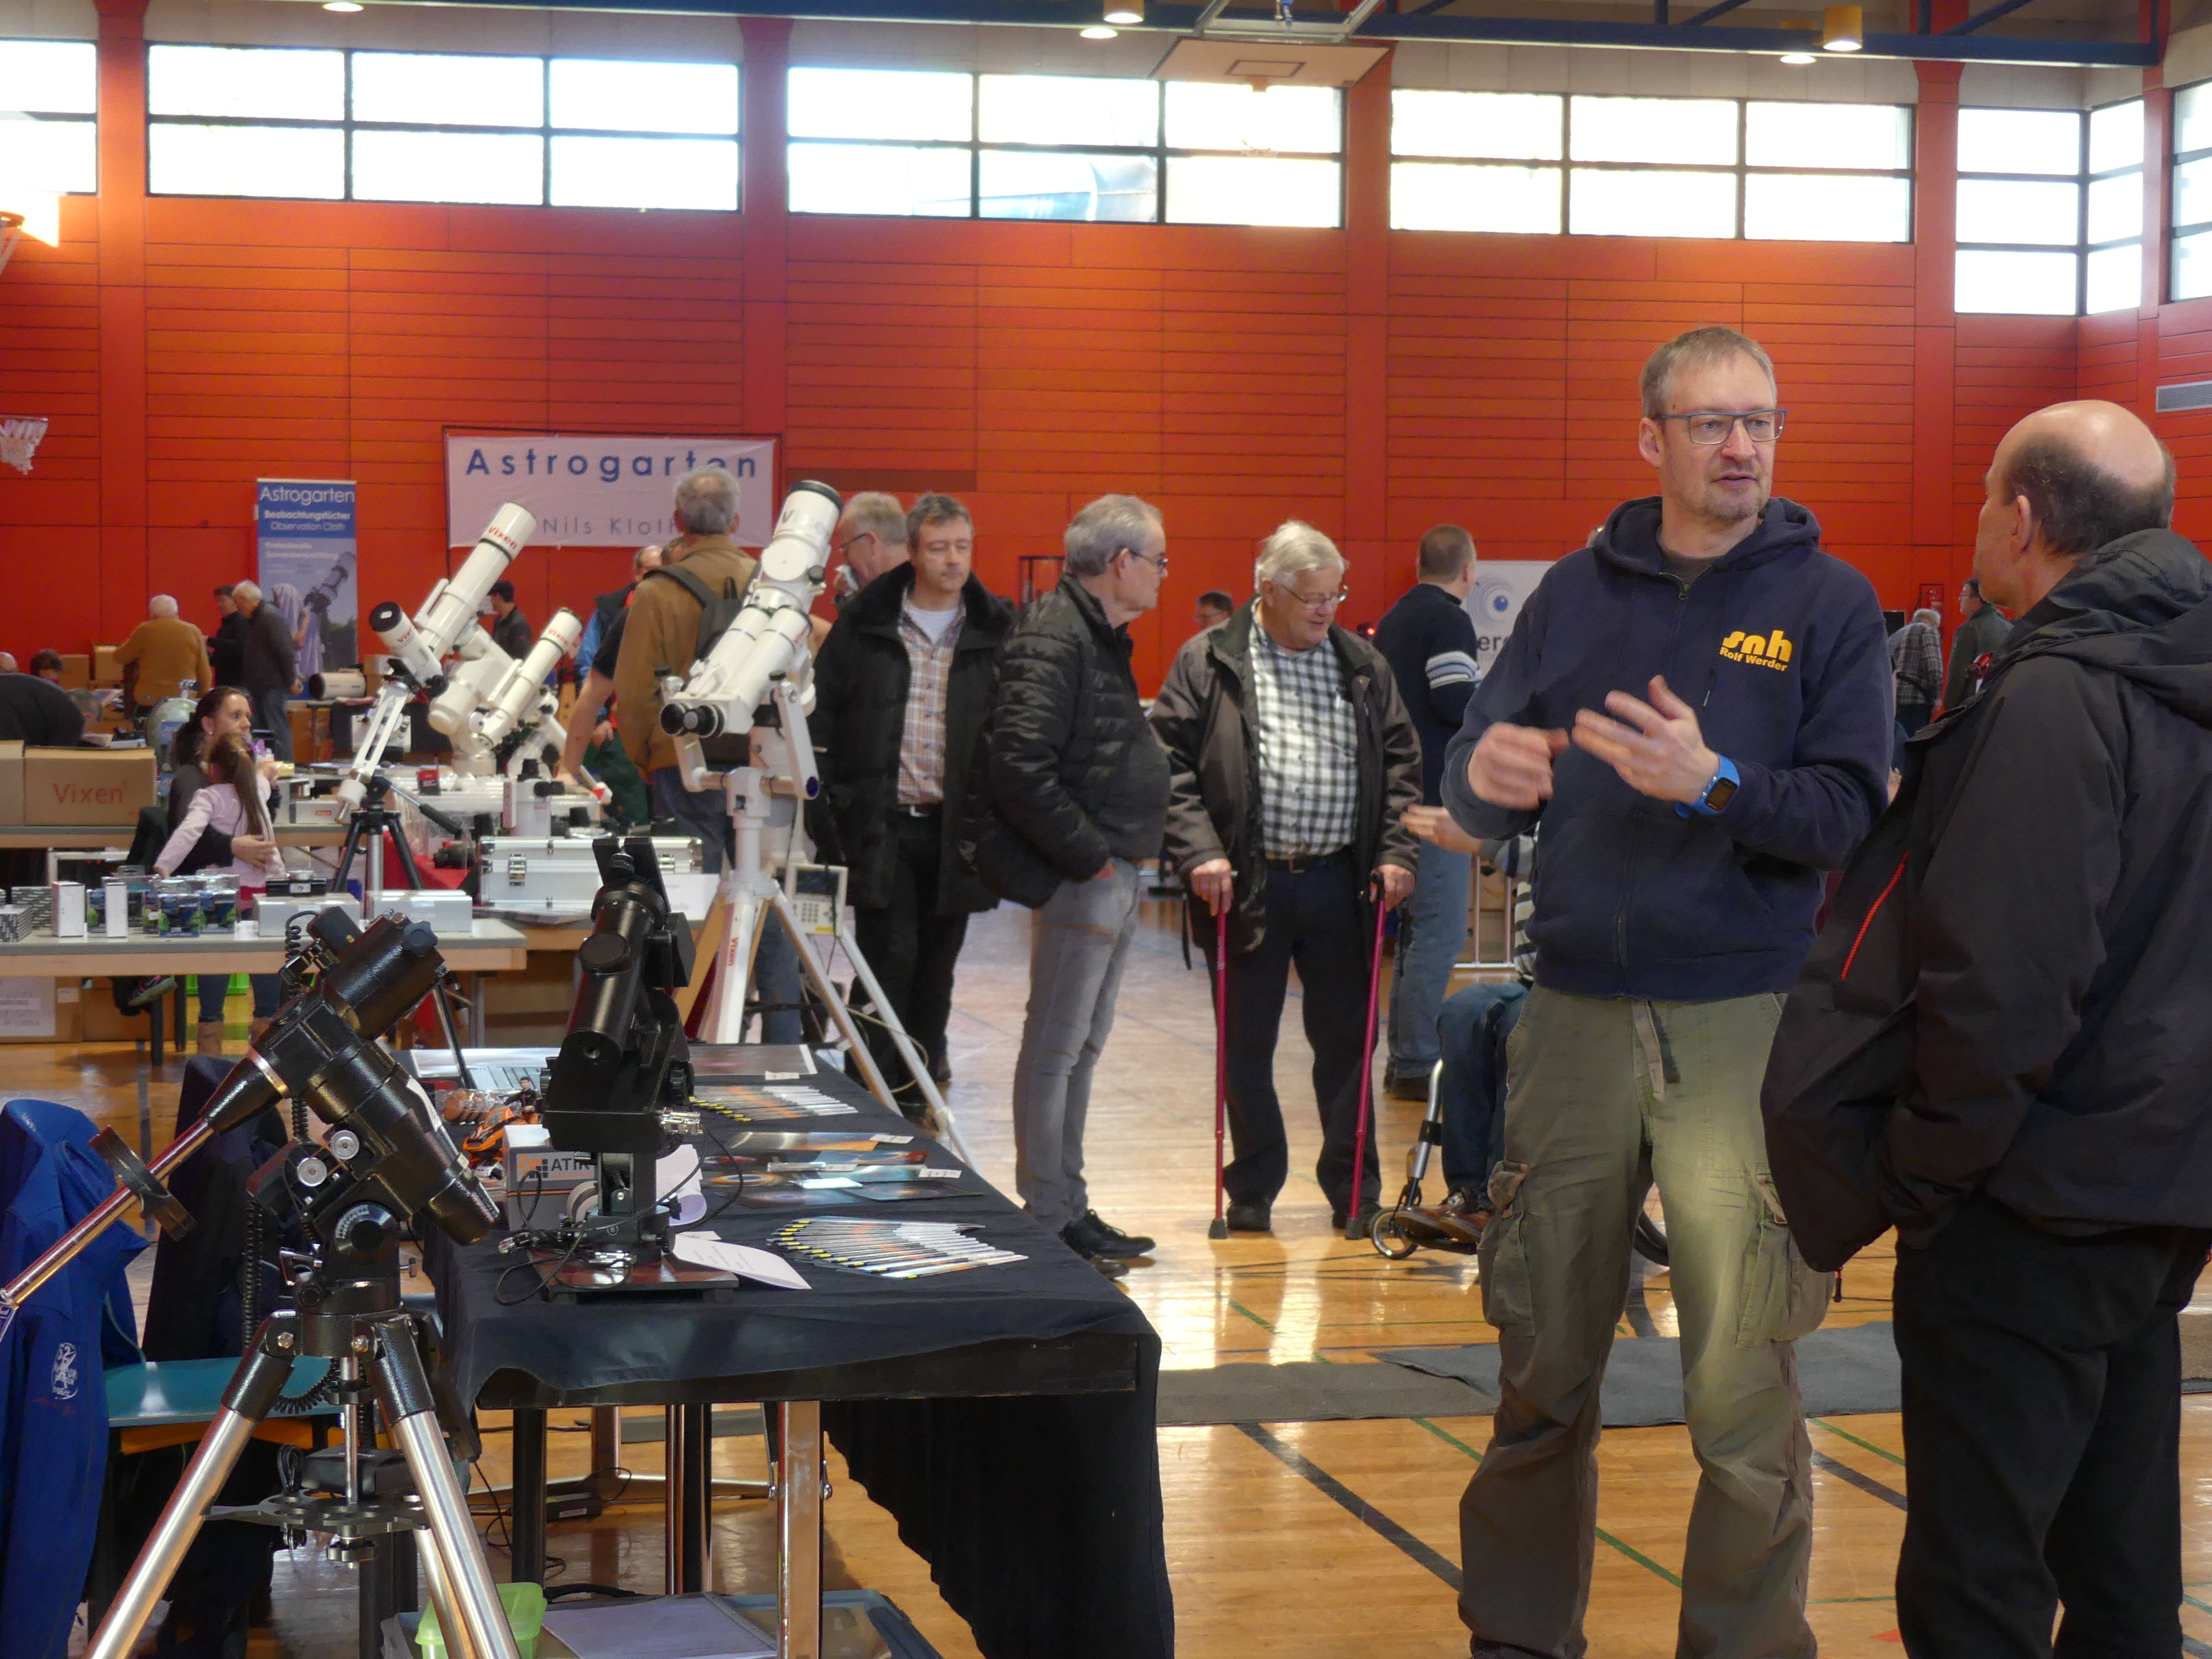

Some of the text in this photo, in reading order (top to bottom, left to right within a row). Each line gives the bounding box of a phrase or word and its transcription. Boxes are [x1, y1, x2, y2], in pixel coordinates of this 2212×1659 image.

[259, 487, 355, 506] Astrogarten
[543, 517, 592, 535] Nils
[1477, 635, 1510, 651] er
[1719, 646, 1788, 672] Rolf Werder
[53, 782, 123, 804] Vixen
[728, 937, 739, 967] Vixen
